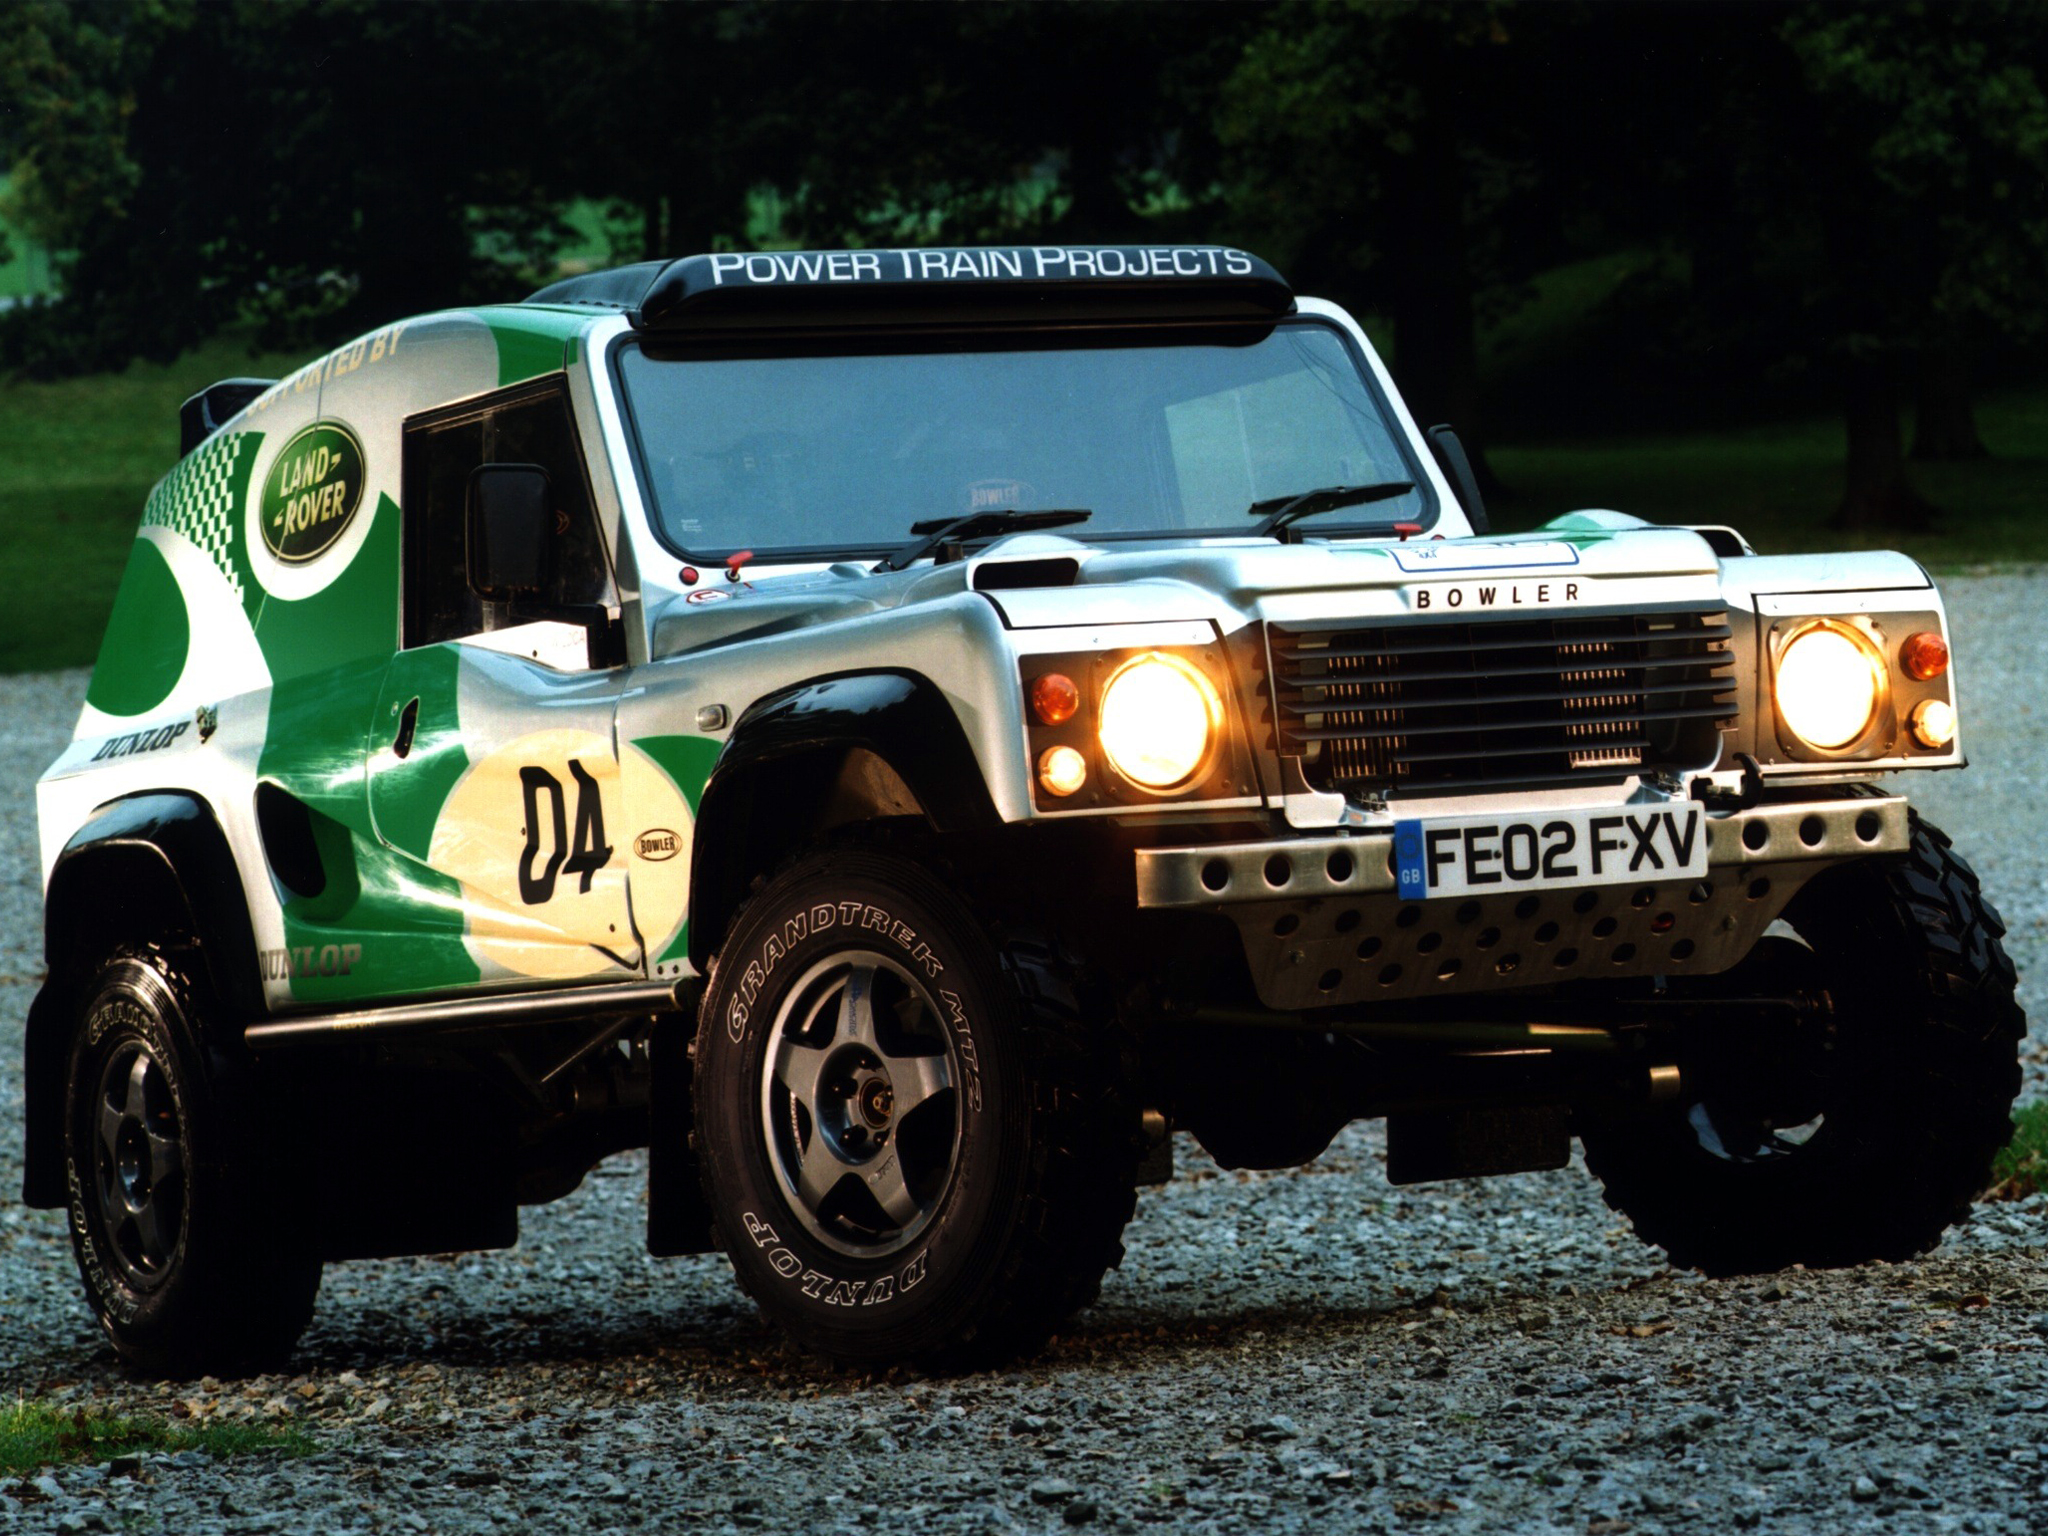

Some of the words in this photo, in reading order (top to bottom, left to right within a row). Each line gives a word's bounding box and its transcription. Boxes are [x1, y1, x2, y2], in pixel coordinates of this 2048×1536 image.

[709, 253, 881, 286] POWER
[889, 248, 1022, 280] TRAIN
[1032, 246, 1253, 277] PROJECTS
[369, 326, 405, 363] BY
[1416, 583, 1579, 609] BOWLER
[90, 720, 192, 762] DUNLOP
[640, 836, 675, 854] BOWLER
[1425, 820, 1578, 888] FE02
[1589, 809, 1698, 875] FXV
[1401, 868, 1421, 884] GB
[260, 943, 362, 981] DUNLOP
[726, 901, 944, 1044] GRANDTREK
[939, 989, 982, 1113] MT2
[67, 1157, 139, 1324] DUNLOP
[742, 1211, 928, 1307] DUNLOP
